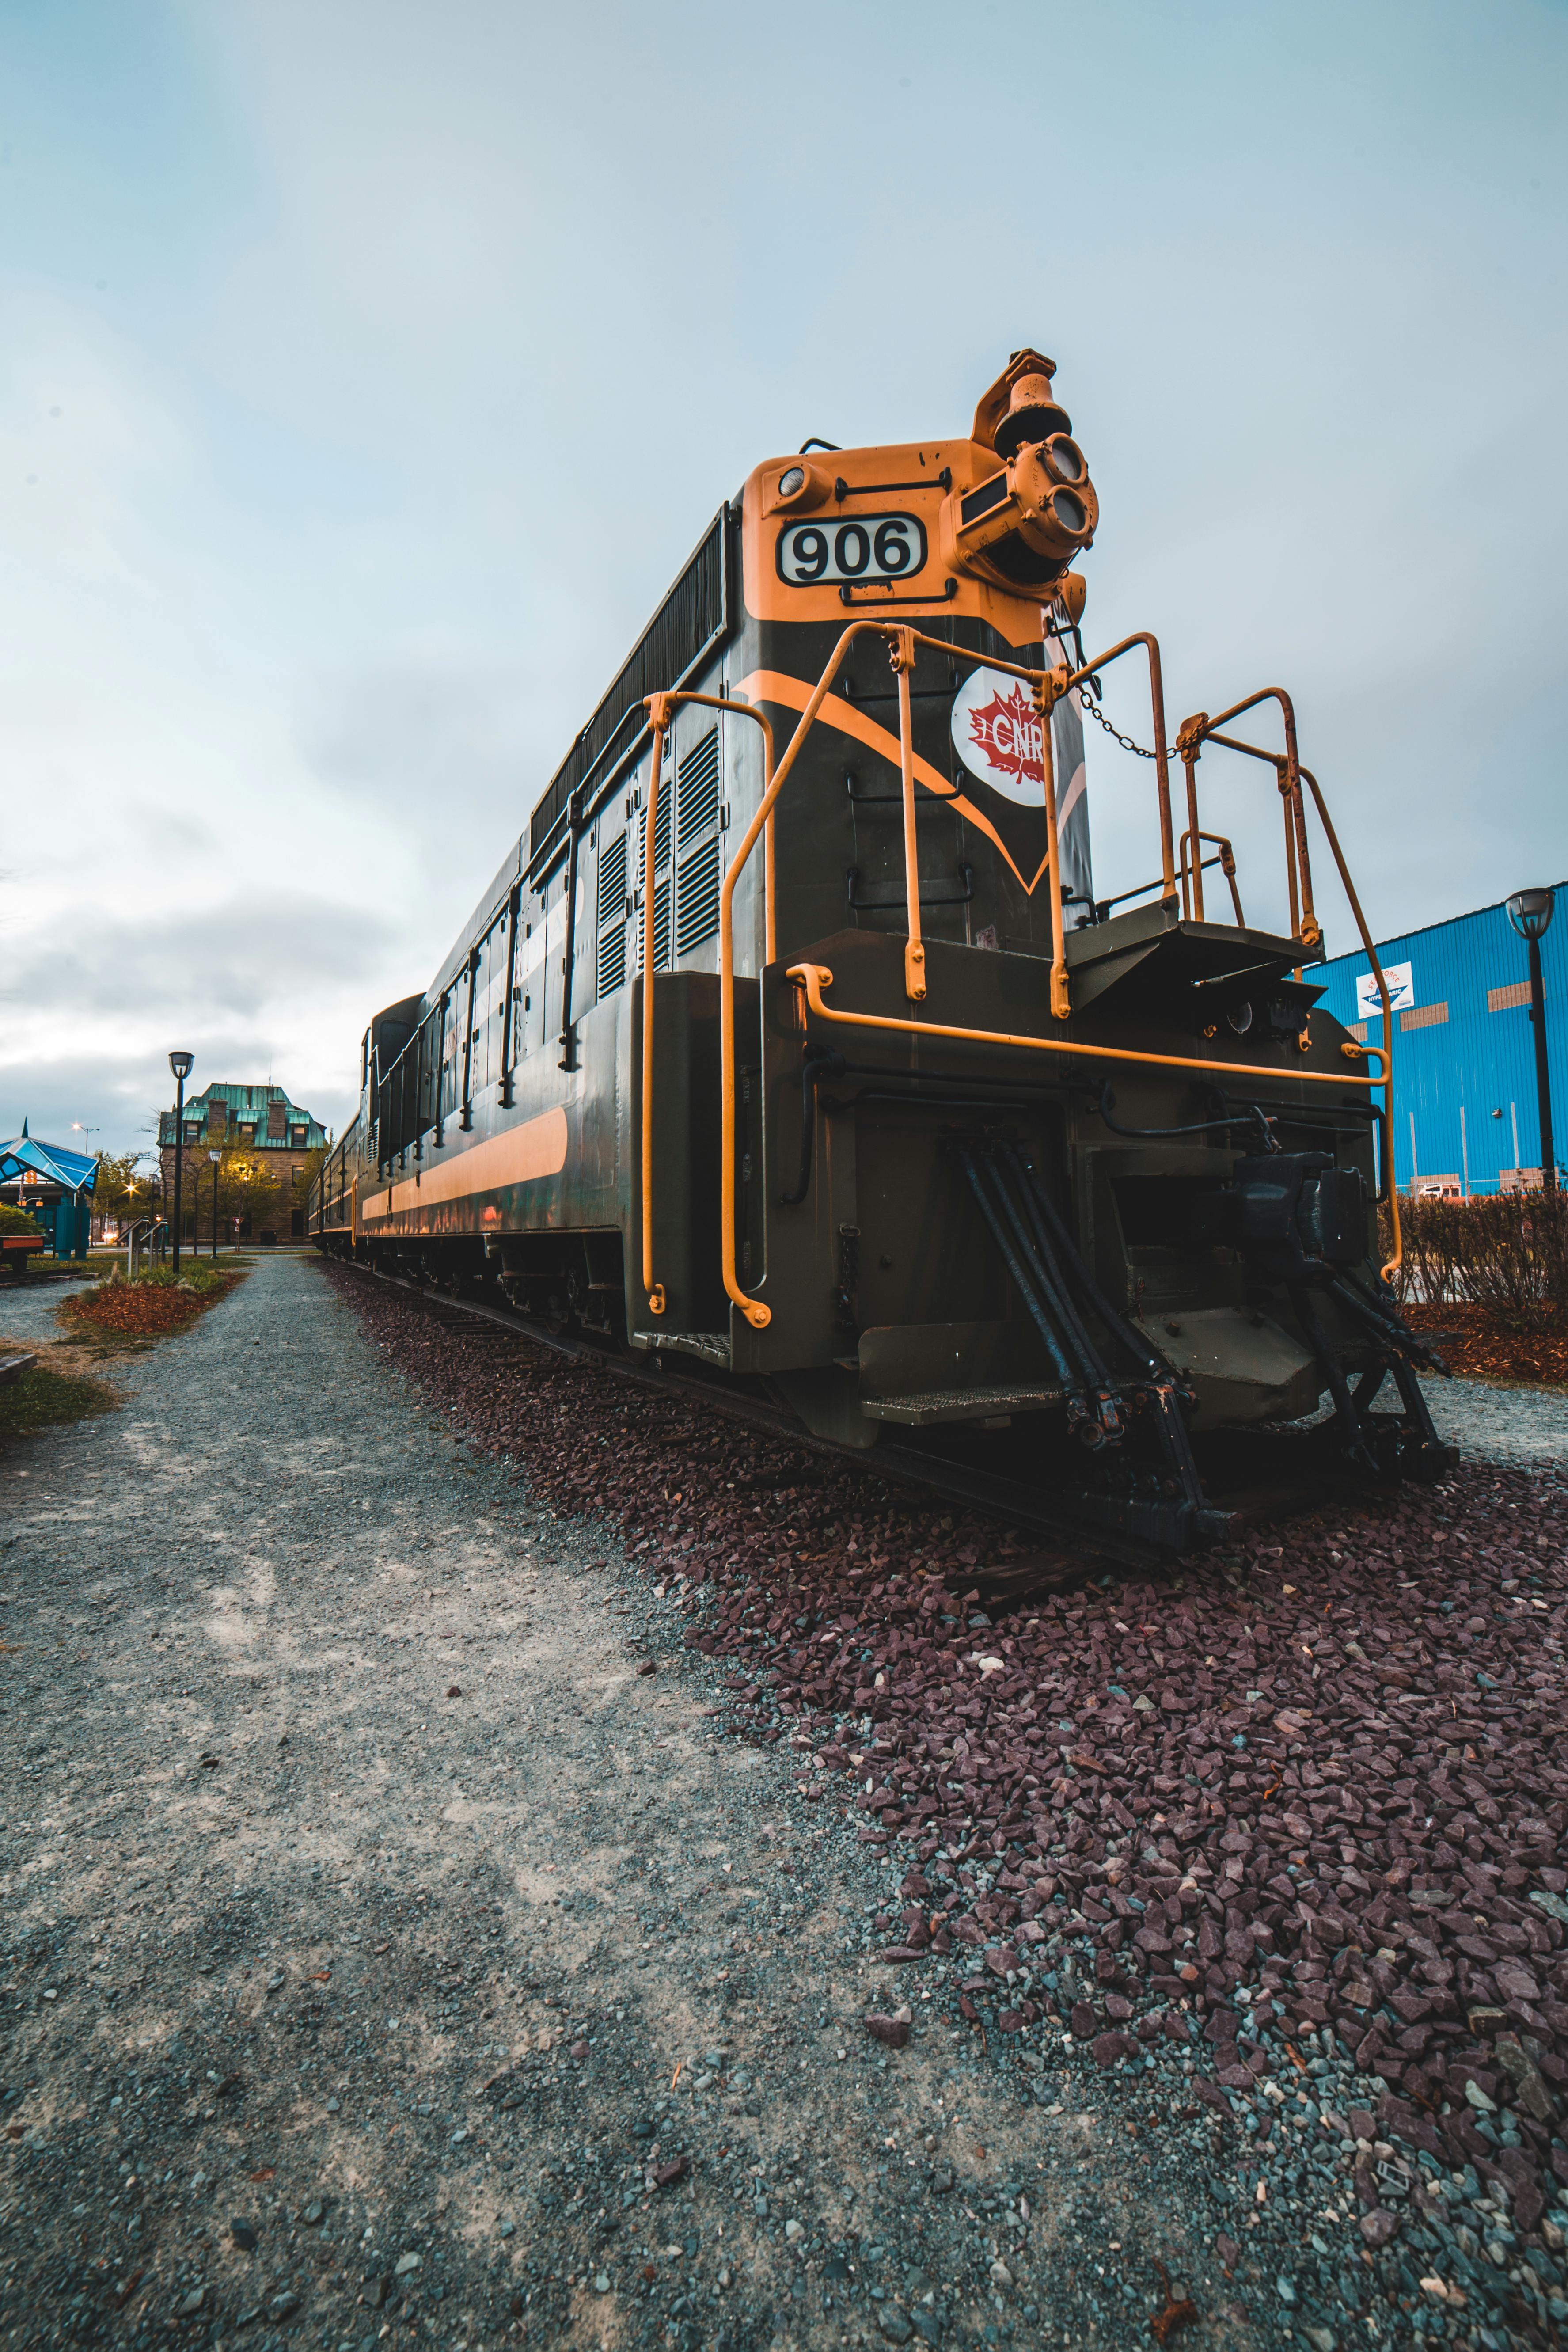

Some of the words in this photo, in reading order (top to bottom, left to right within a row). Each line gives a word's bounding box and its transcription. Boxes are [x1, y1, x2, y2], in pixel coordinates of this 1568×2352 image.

[793, 520, 910, 581] 906
[992, 714, 1044, 764] CNR
[1368, 989, 1401, 1002] HYPEARIC
